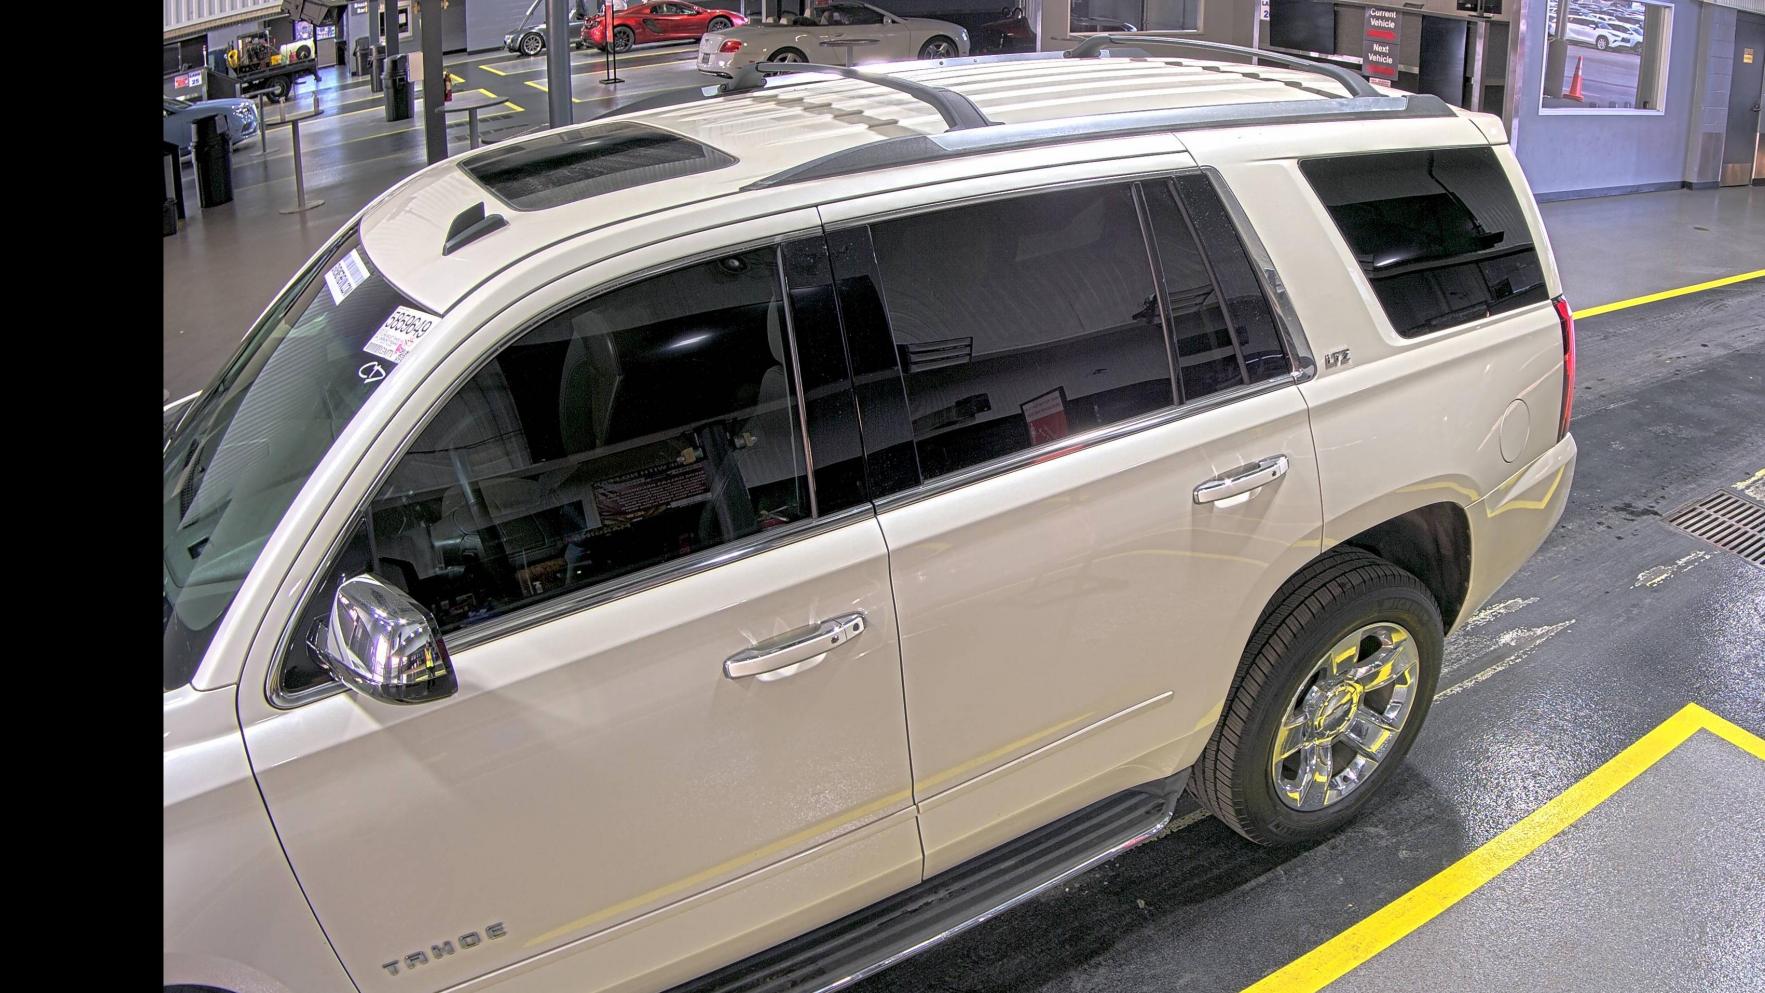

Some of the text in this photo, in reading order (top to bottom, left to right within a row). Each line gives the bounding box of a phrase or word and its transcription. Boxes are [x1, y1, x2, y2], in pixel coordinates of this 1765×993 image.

[1370, 8, 1397, 18] Current
[1370, 18, 1395, 29] Vehicle
[1373, 43, 1389, 53] Next
[1368, 53, 1393, 64] Vehicle
[385, 311, 432, 338] 5859649
[1324, 348, 1351, 370] LTZ
[382, 921, 508, 976] TAHOE
